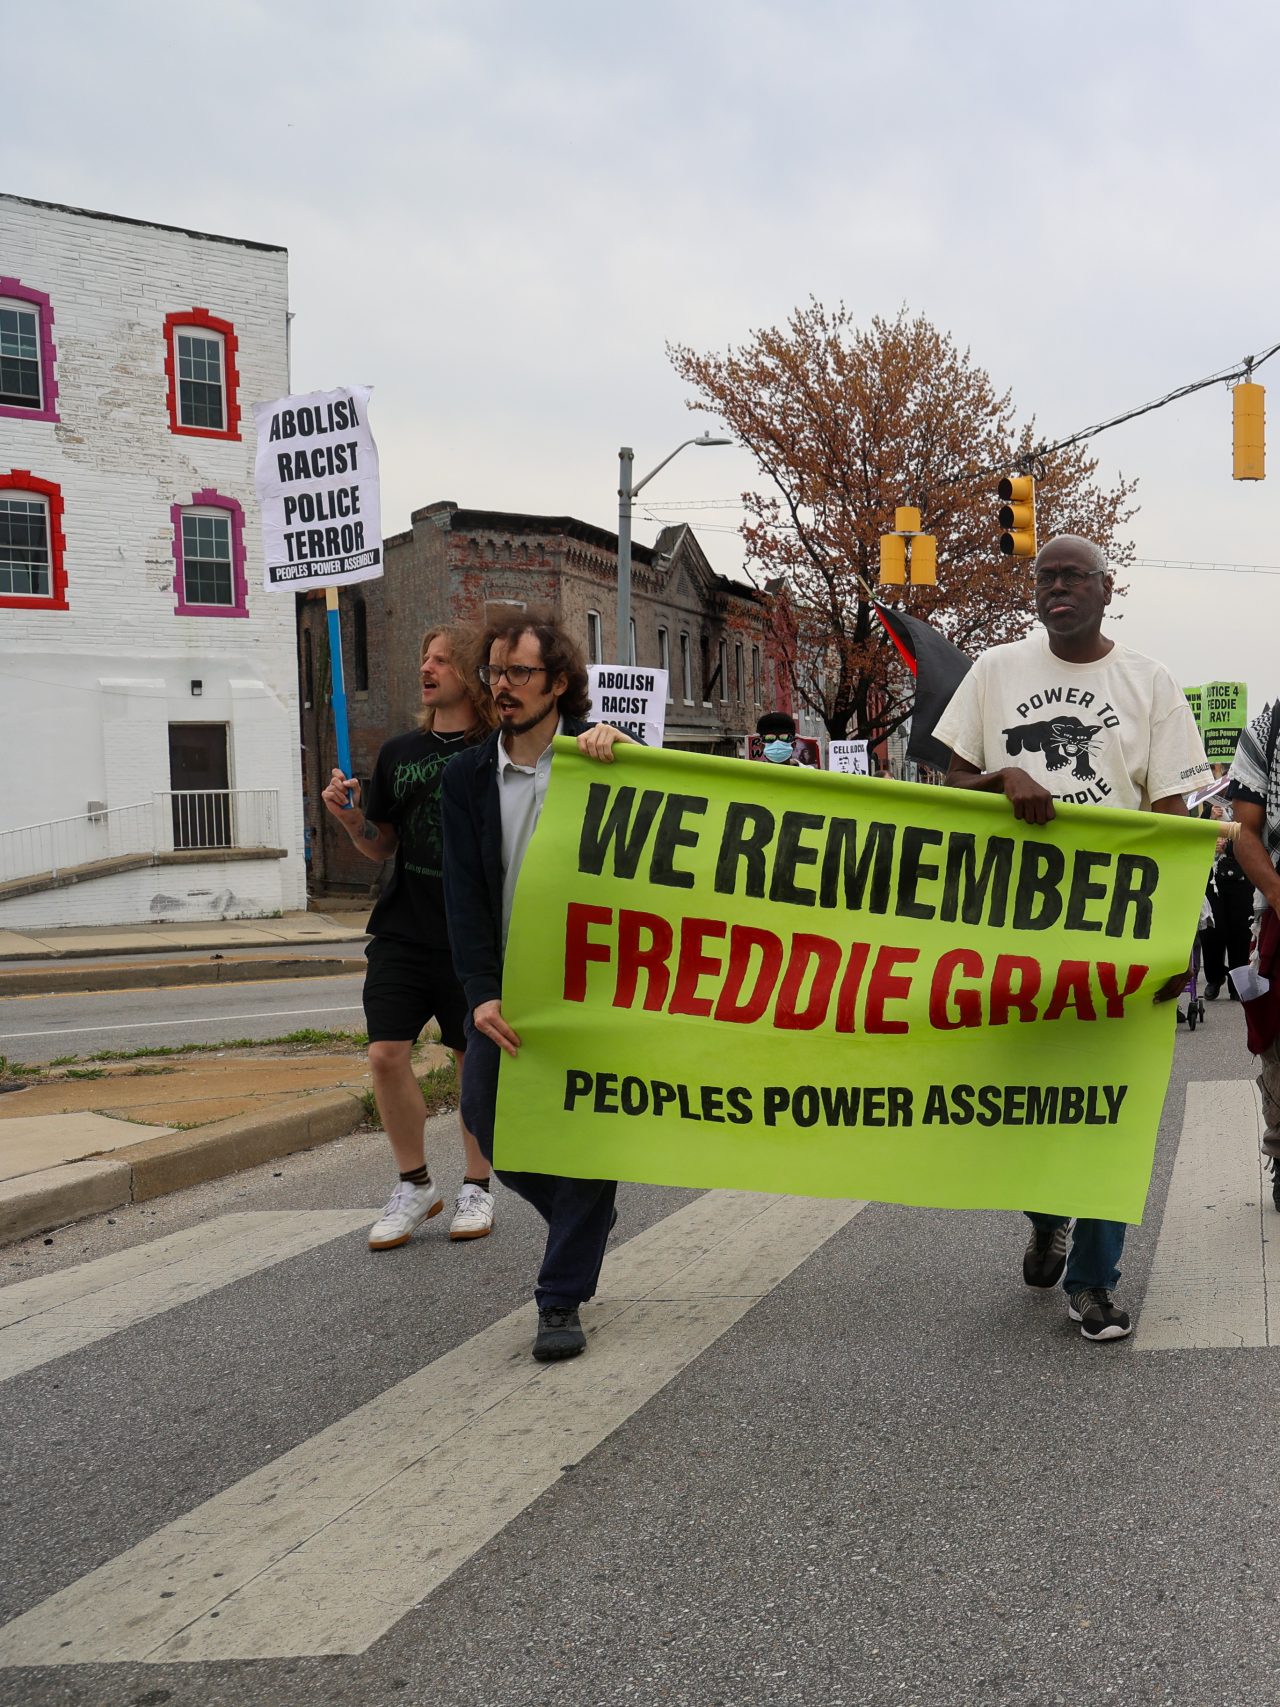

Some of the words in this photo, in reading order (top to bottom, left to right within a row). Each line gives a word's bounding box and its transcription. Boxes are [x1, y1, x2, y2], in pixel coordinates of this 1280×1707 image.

[269, 397, 360, 443] ABOLISH
[277, 441, 358, 483] RACIST
[284, 485, 361, 526] POLICE
[284, 521, 365, 562] TERROR
[276, 564, 308, 581] PEOPLES
[311, 557, 341, 576] POWER
[344, 551, 375, 571] ASSEMBLY
[598, 672, 654, 692] ABOLISH
[1233, 686, 1239, 697] 4
[602, 696, 648, 715] RACIST
[1016, 686, 1096, 719] POWER
[1096, 703, 1121, 729] TO
[1210, 712, 1230, 722] RAY!
[833, 746, 850, 754] CELL
[578, 782, 708, 889] WE
[714, 801, 1160, 940] REMEMBER
[563, 901, 920, 1035] FREDDIE
[929, 947, 1150, 1031] GRAY
[564, 1068, 754, 1125] PEOPLES
[764, 1084, 914, 1128] POWER
[922, 1083, 1128, 1128] ASSEMBLY
